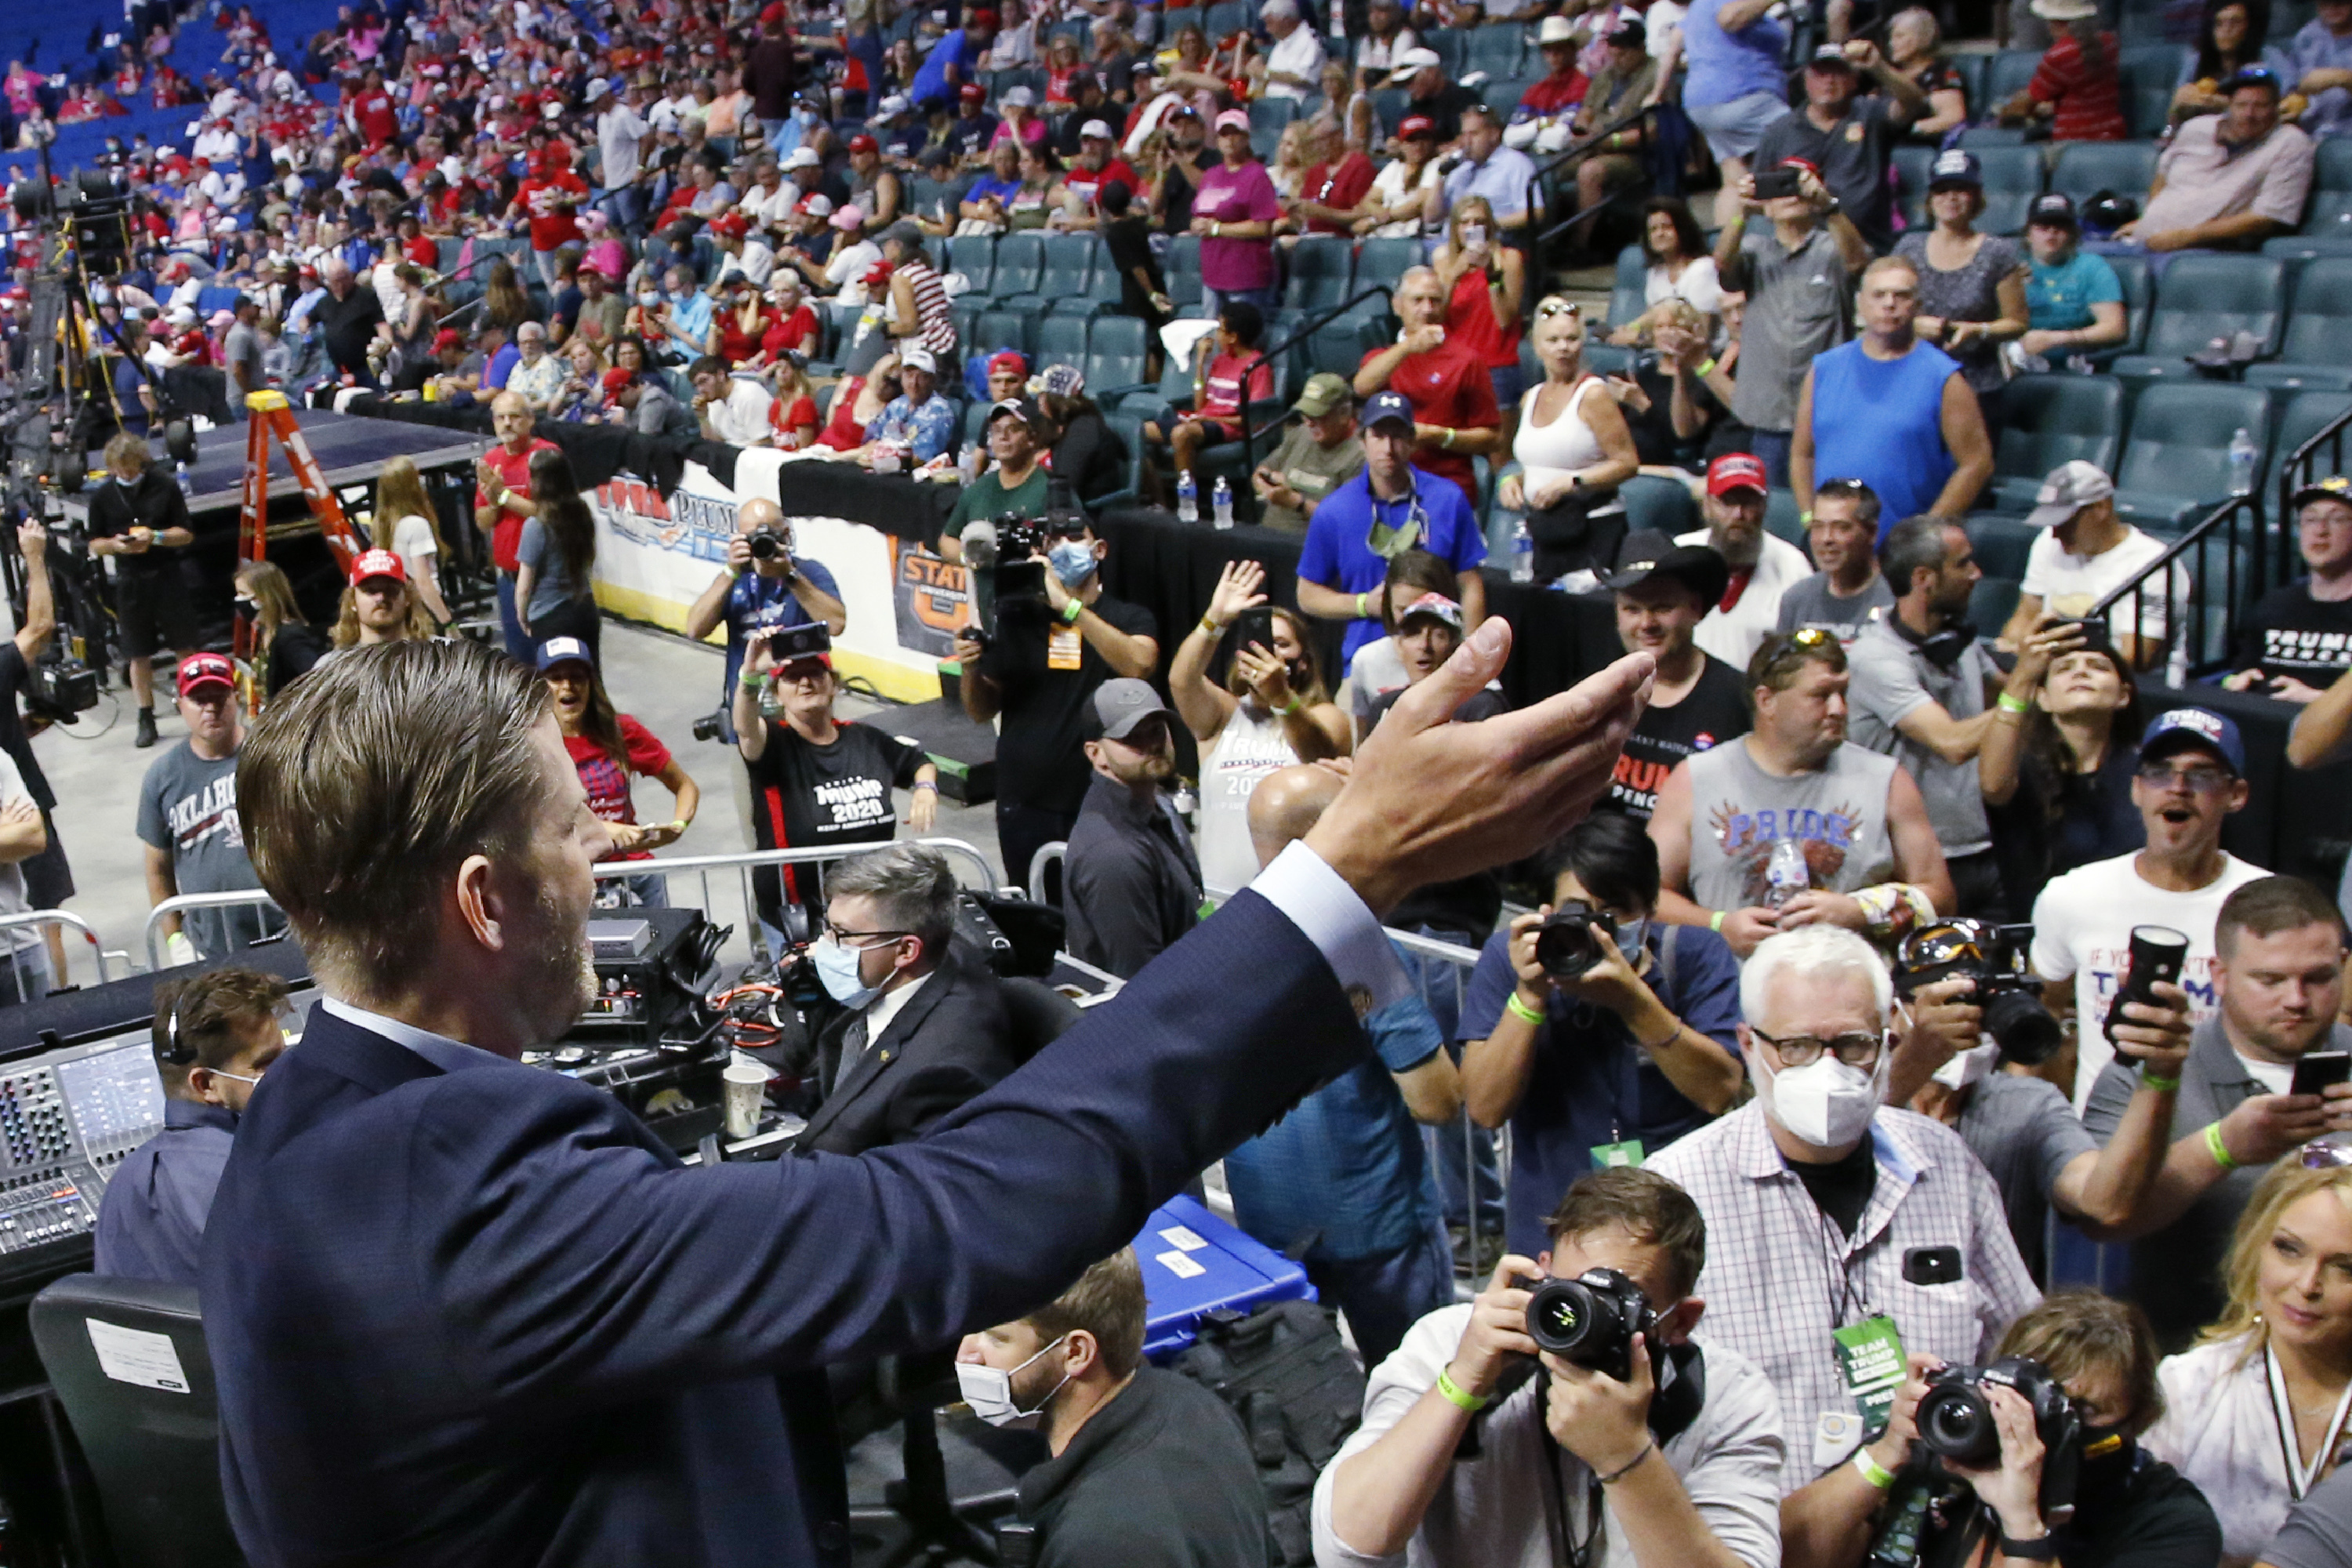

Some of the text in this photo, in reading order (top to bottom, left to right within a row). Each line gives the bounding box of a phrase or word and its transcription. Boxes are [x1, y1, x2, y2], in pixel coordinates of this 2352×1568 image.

[674, 490, 738, 535] PLUM
[904, 555, 967, 592] STAT
[812, 778, 884, 807] TRUMP
[1611, 783, 1659, 810] PENC
[830, 797, 885, 824] 2020
[1727, 807, 1851, 848] PRIDE
[2110, 949, 2133, 967] YO
[1847, 1347, 1896, 1371] TRUMP
[1849, 1337, 1889, 1358] TEAM
